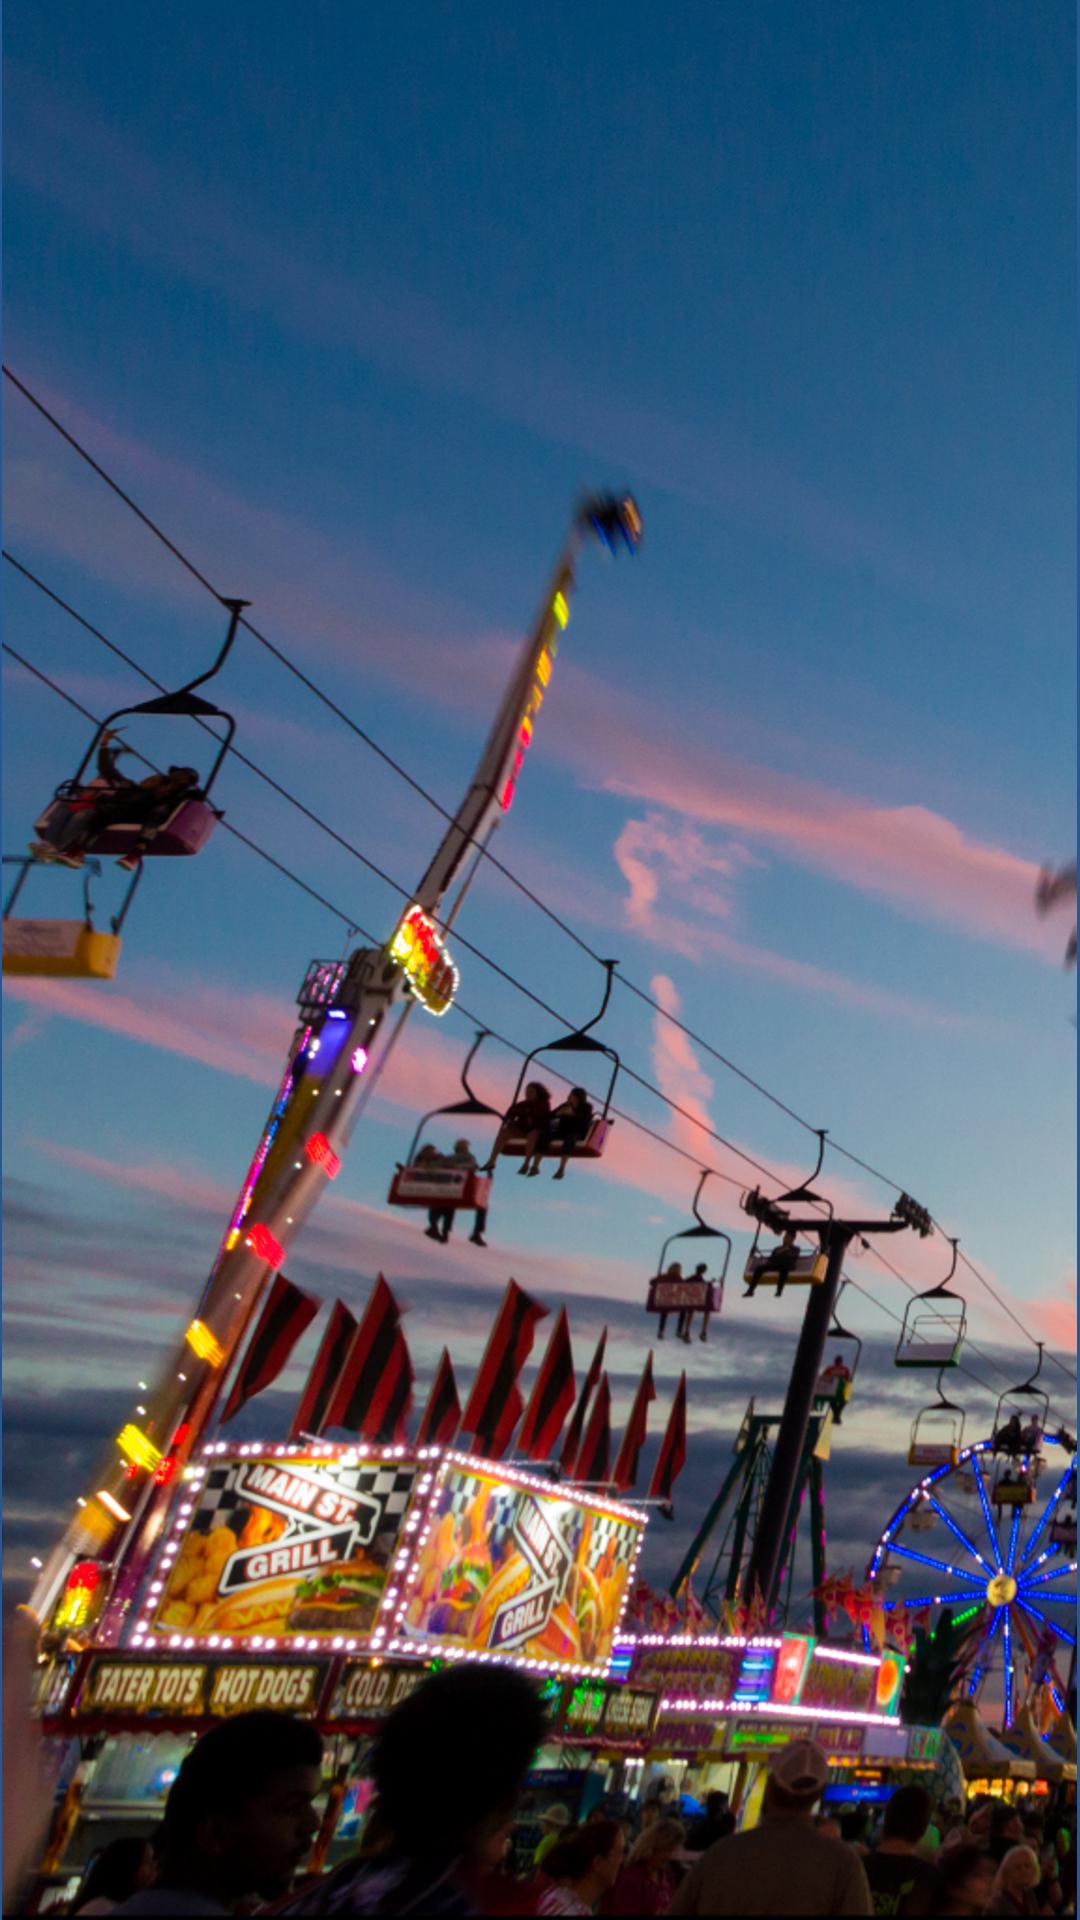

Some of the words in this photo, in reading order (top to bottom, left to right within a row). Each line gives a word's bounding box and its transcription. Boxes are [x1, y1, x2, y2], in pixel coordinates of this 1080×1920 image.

[246, 1464, 319, 1511] MAIN
[314, 1491, 358, 1524] ST.
[245, 1538, 338, 1580] GRILL
[501, 1595, 545, 1640] GRILL
[95, 1667, 155, 1702] TATER
[151, 1667, 203, 1703] TOTS
[214, 1667, 260, 1704] HOT
[255, 1668, 314, 1704] DOGS
[346, 1669, 390, 1706] COLD
